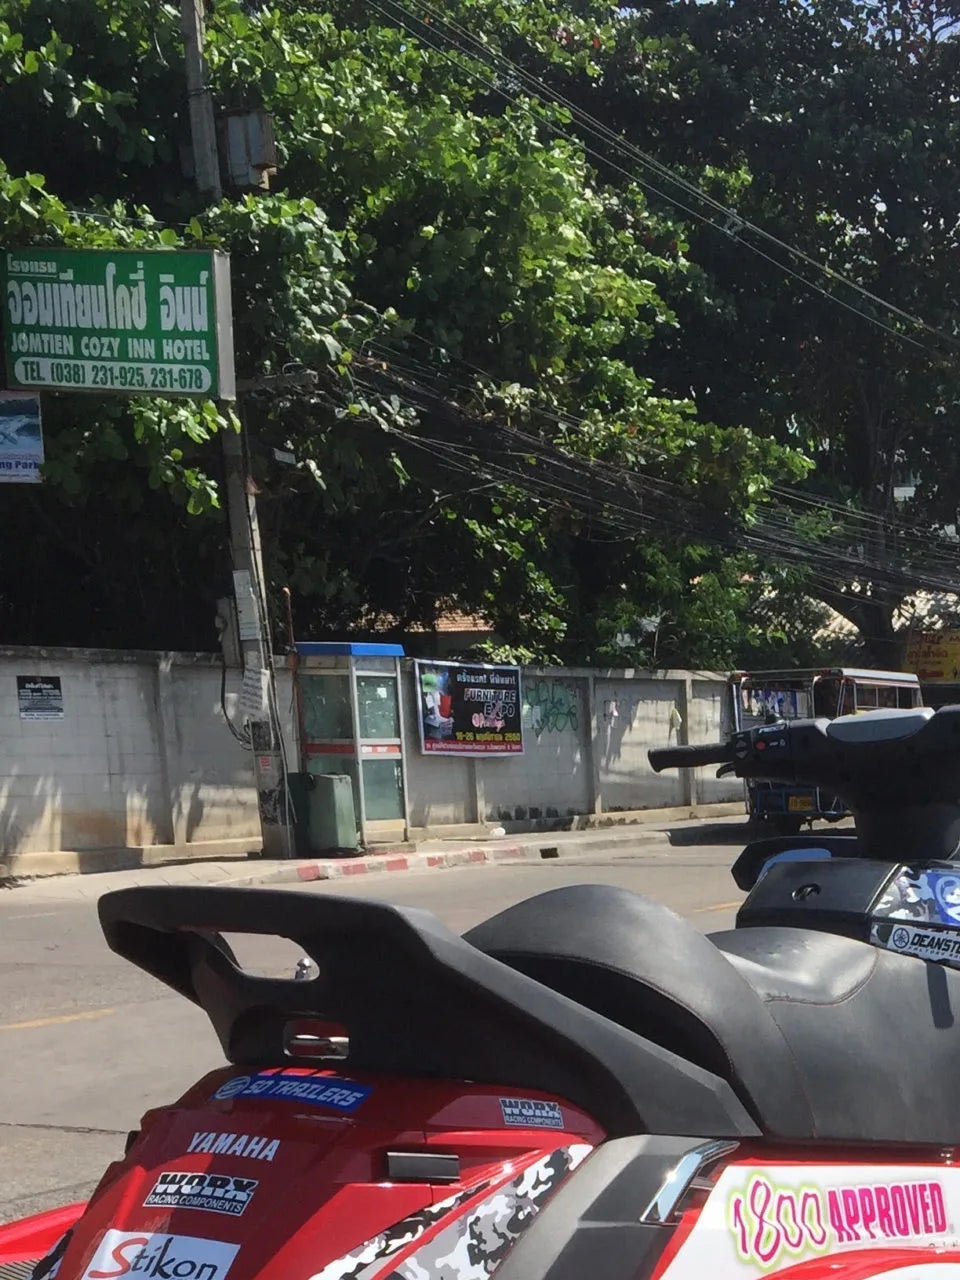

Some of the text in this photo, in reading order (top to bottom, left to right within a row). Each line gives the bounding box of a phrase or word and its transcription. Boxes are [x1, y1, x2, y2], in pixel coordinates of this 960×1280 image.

[7, 254, 57, 273] โรงแรม
[159, 270, 209, 332] อินน์
[11, 331, 210, 361] JOMTIEN COZY INN HOTEL
[22, 361, 45, 382] TEL.
[51, 362, 86, 384] (038)
[464, 688, 517, 702] FURNITURE
[485, 702, 516, 718] EXPO
[269, 1080, 364, 1107] TRAILERS
[500, 1099, 560, 1119] WORX
[187, 1131, 281, 1162] YAMAHA
[155, 1173, 259, 1202] WORX
[146, 1194, 243, 1213] RACING COMPONENTS
[733, 1179, 948, 1262] 1800 APPROVED
